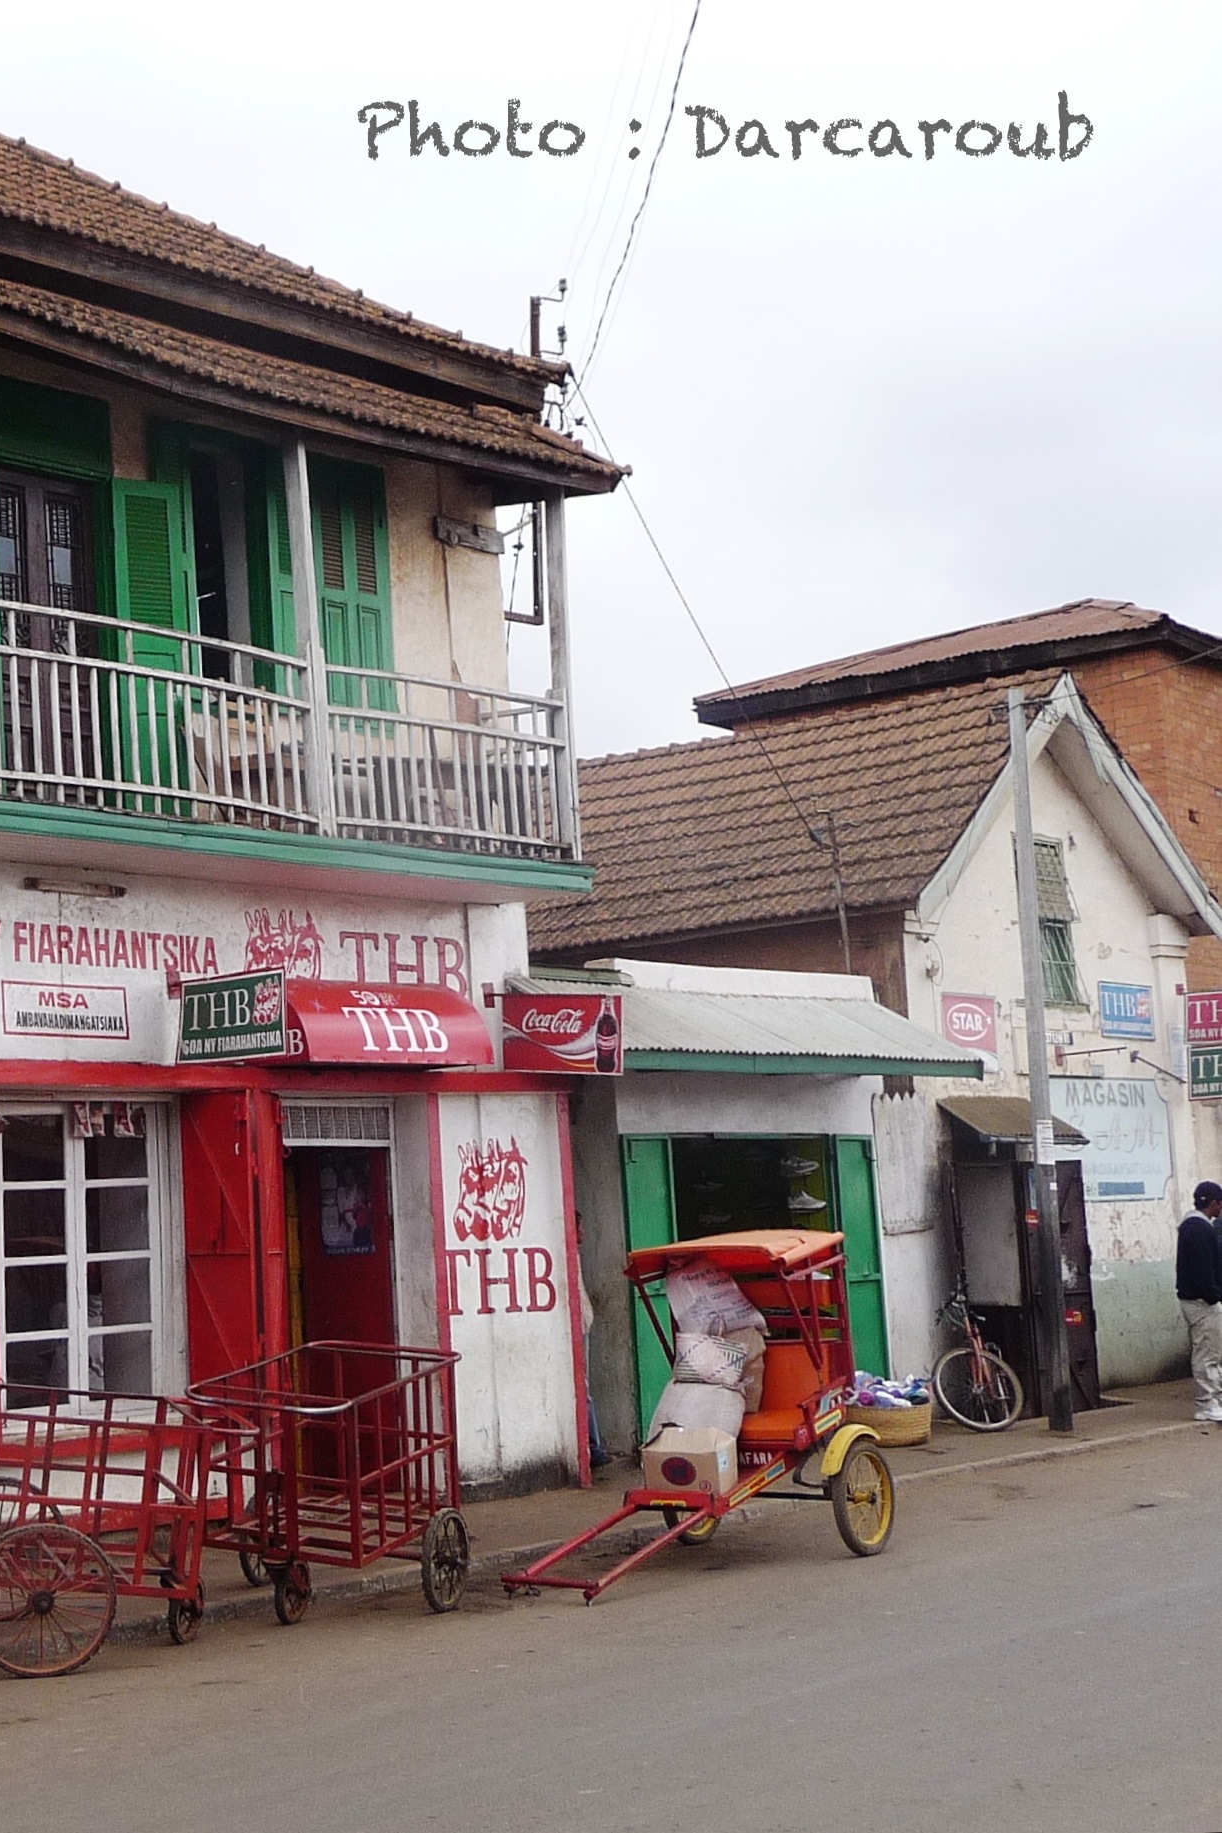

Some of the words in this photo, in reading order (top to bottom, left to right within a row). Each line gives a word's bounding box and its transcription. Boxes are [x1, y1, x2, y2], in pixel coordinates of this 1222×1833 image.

[13, 921, 220, 975] FIARAHANTSIKA
[339, 931, 467, 997] THB
[38, 991, 89, 1009] MSA
[185, 988, 251, 1031] THB
[1101, 991, 1136, 1017] THB
[341, 1006, 449, 1053] THB
[522, 1008, 585, 1034] Coca-Cola
[952, 1011, 983, 1032] STAR
[182, 1039, 203, 1055] SOA
[204, 1038, 217, 1053] NY
[218, 1030, 282, 1052] FIARAHANTSIKA
[1065, 1082, 1145, 1107] MAGASIN
[444, 1247, 557, 1315] THB
